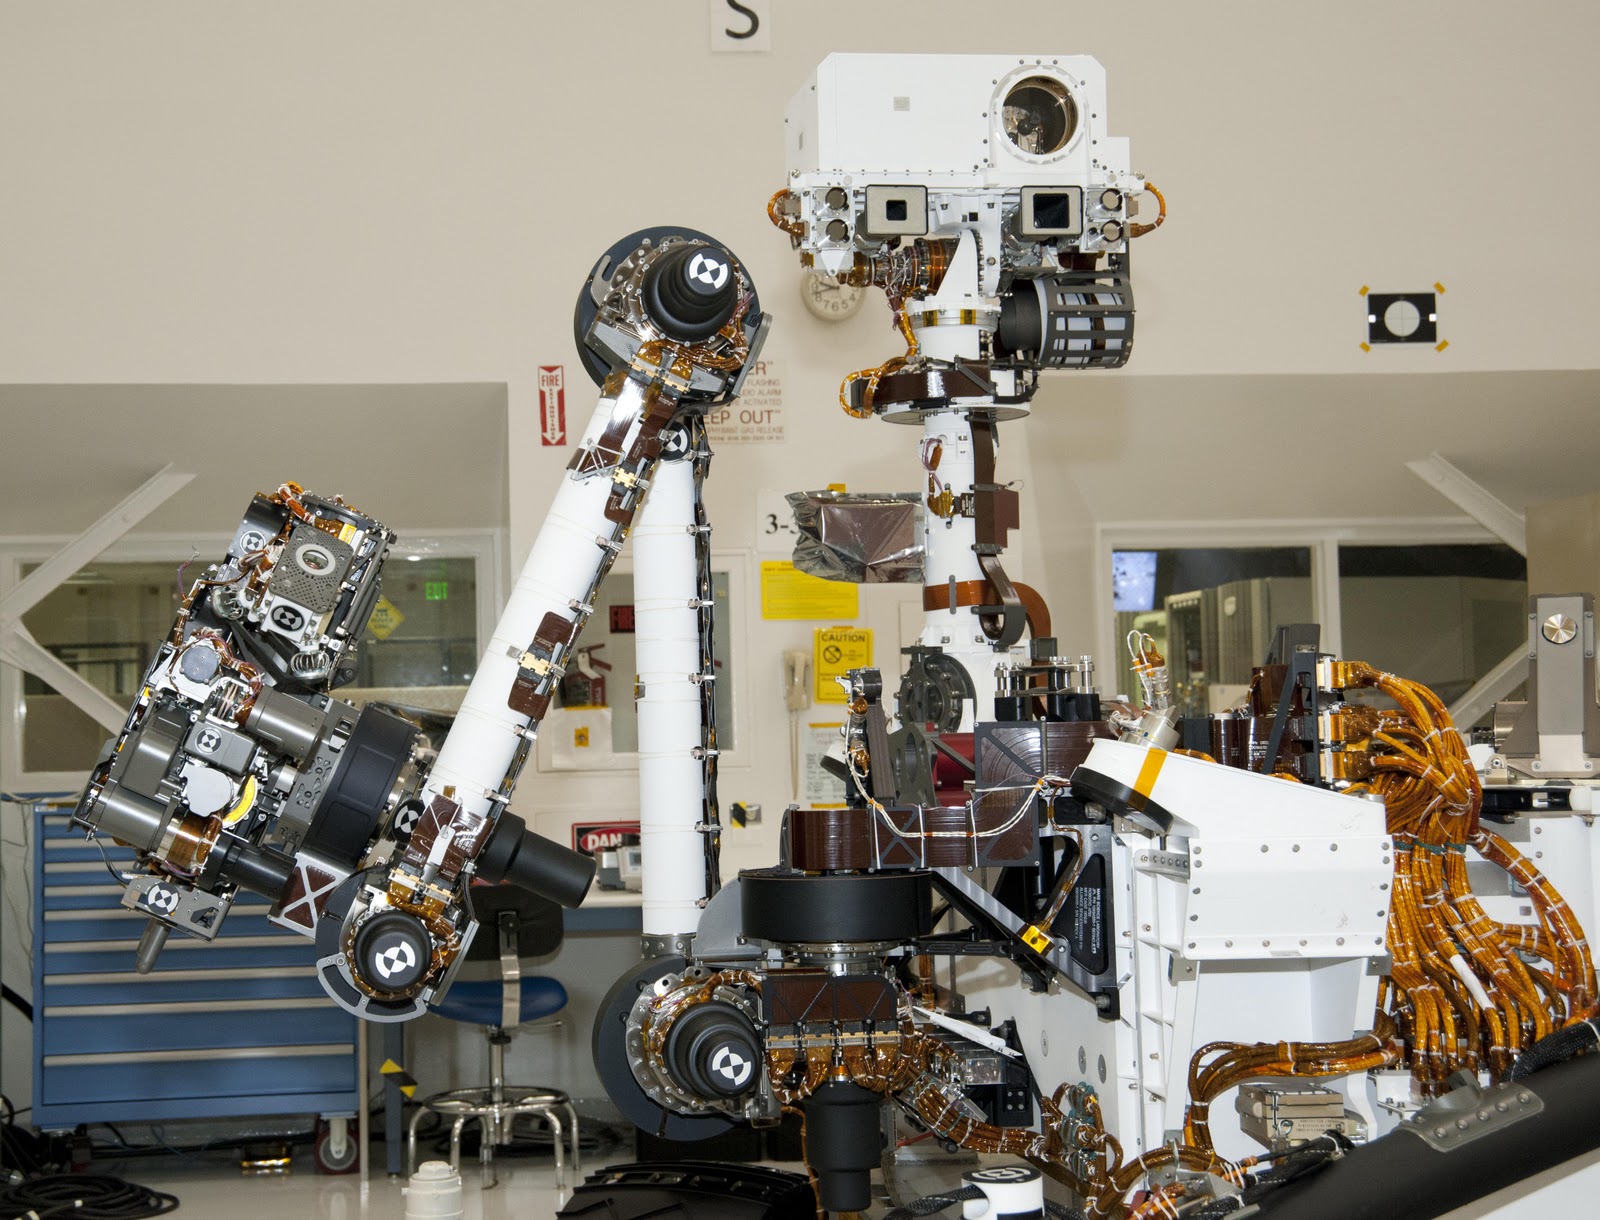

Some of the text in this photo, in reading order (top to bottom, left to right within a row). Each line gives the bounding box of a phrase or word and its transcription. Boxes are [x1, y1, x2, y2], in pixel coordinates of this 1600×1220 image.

[725, 0, 759, 39] S
[823, 300, 830, 309] 7
[831, 301, 839, 311] 6
[841, 300, 849, 309] 5
[541, 374, 560, 387] FIRE
[757, 388, 782, 397] ALARM
[744, 398, 783, 406] ACTIVATED
[821, 633, 866, 643] CAUTION
